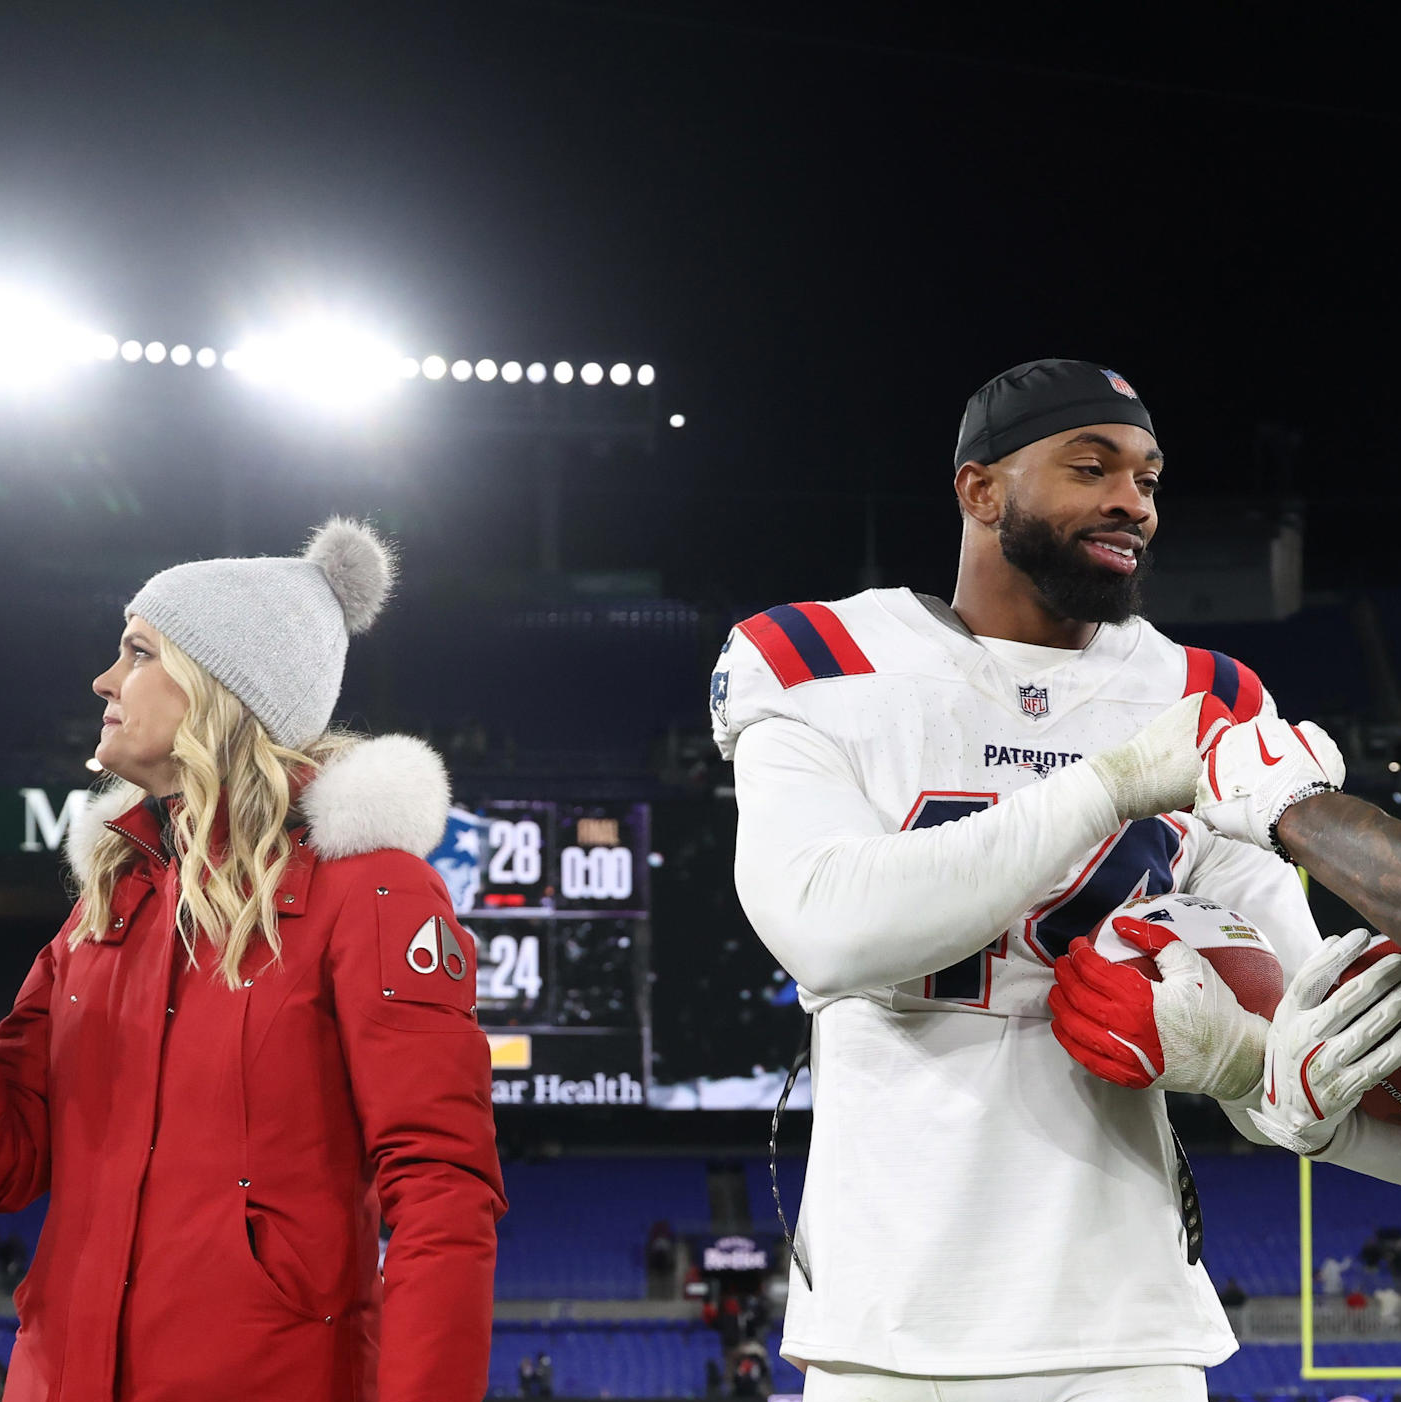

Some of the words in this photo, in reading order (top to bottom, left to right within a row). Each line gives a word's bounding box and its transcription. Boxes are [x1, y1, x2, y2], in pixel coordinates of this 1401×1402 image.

[1023, 698, 1046, 713] NFL
[488, 820, 542, 885] 28
[560, 846, 633, 899] 0:00
[488, 935, 543, 999] 24
[534, 1073, 643, 1105] Health
